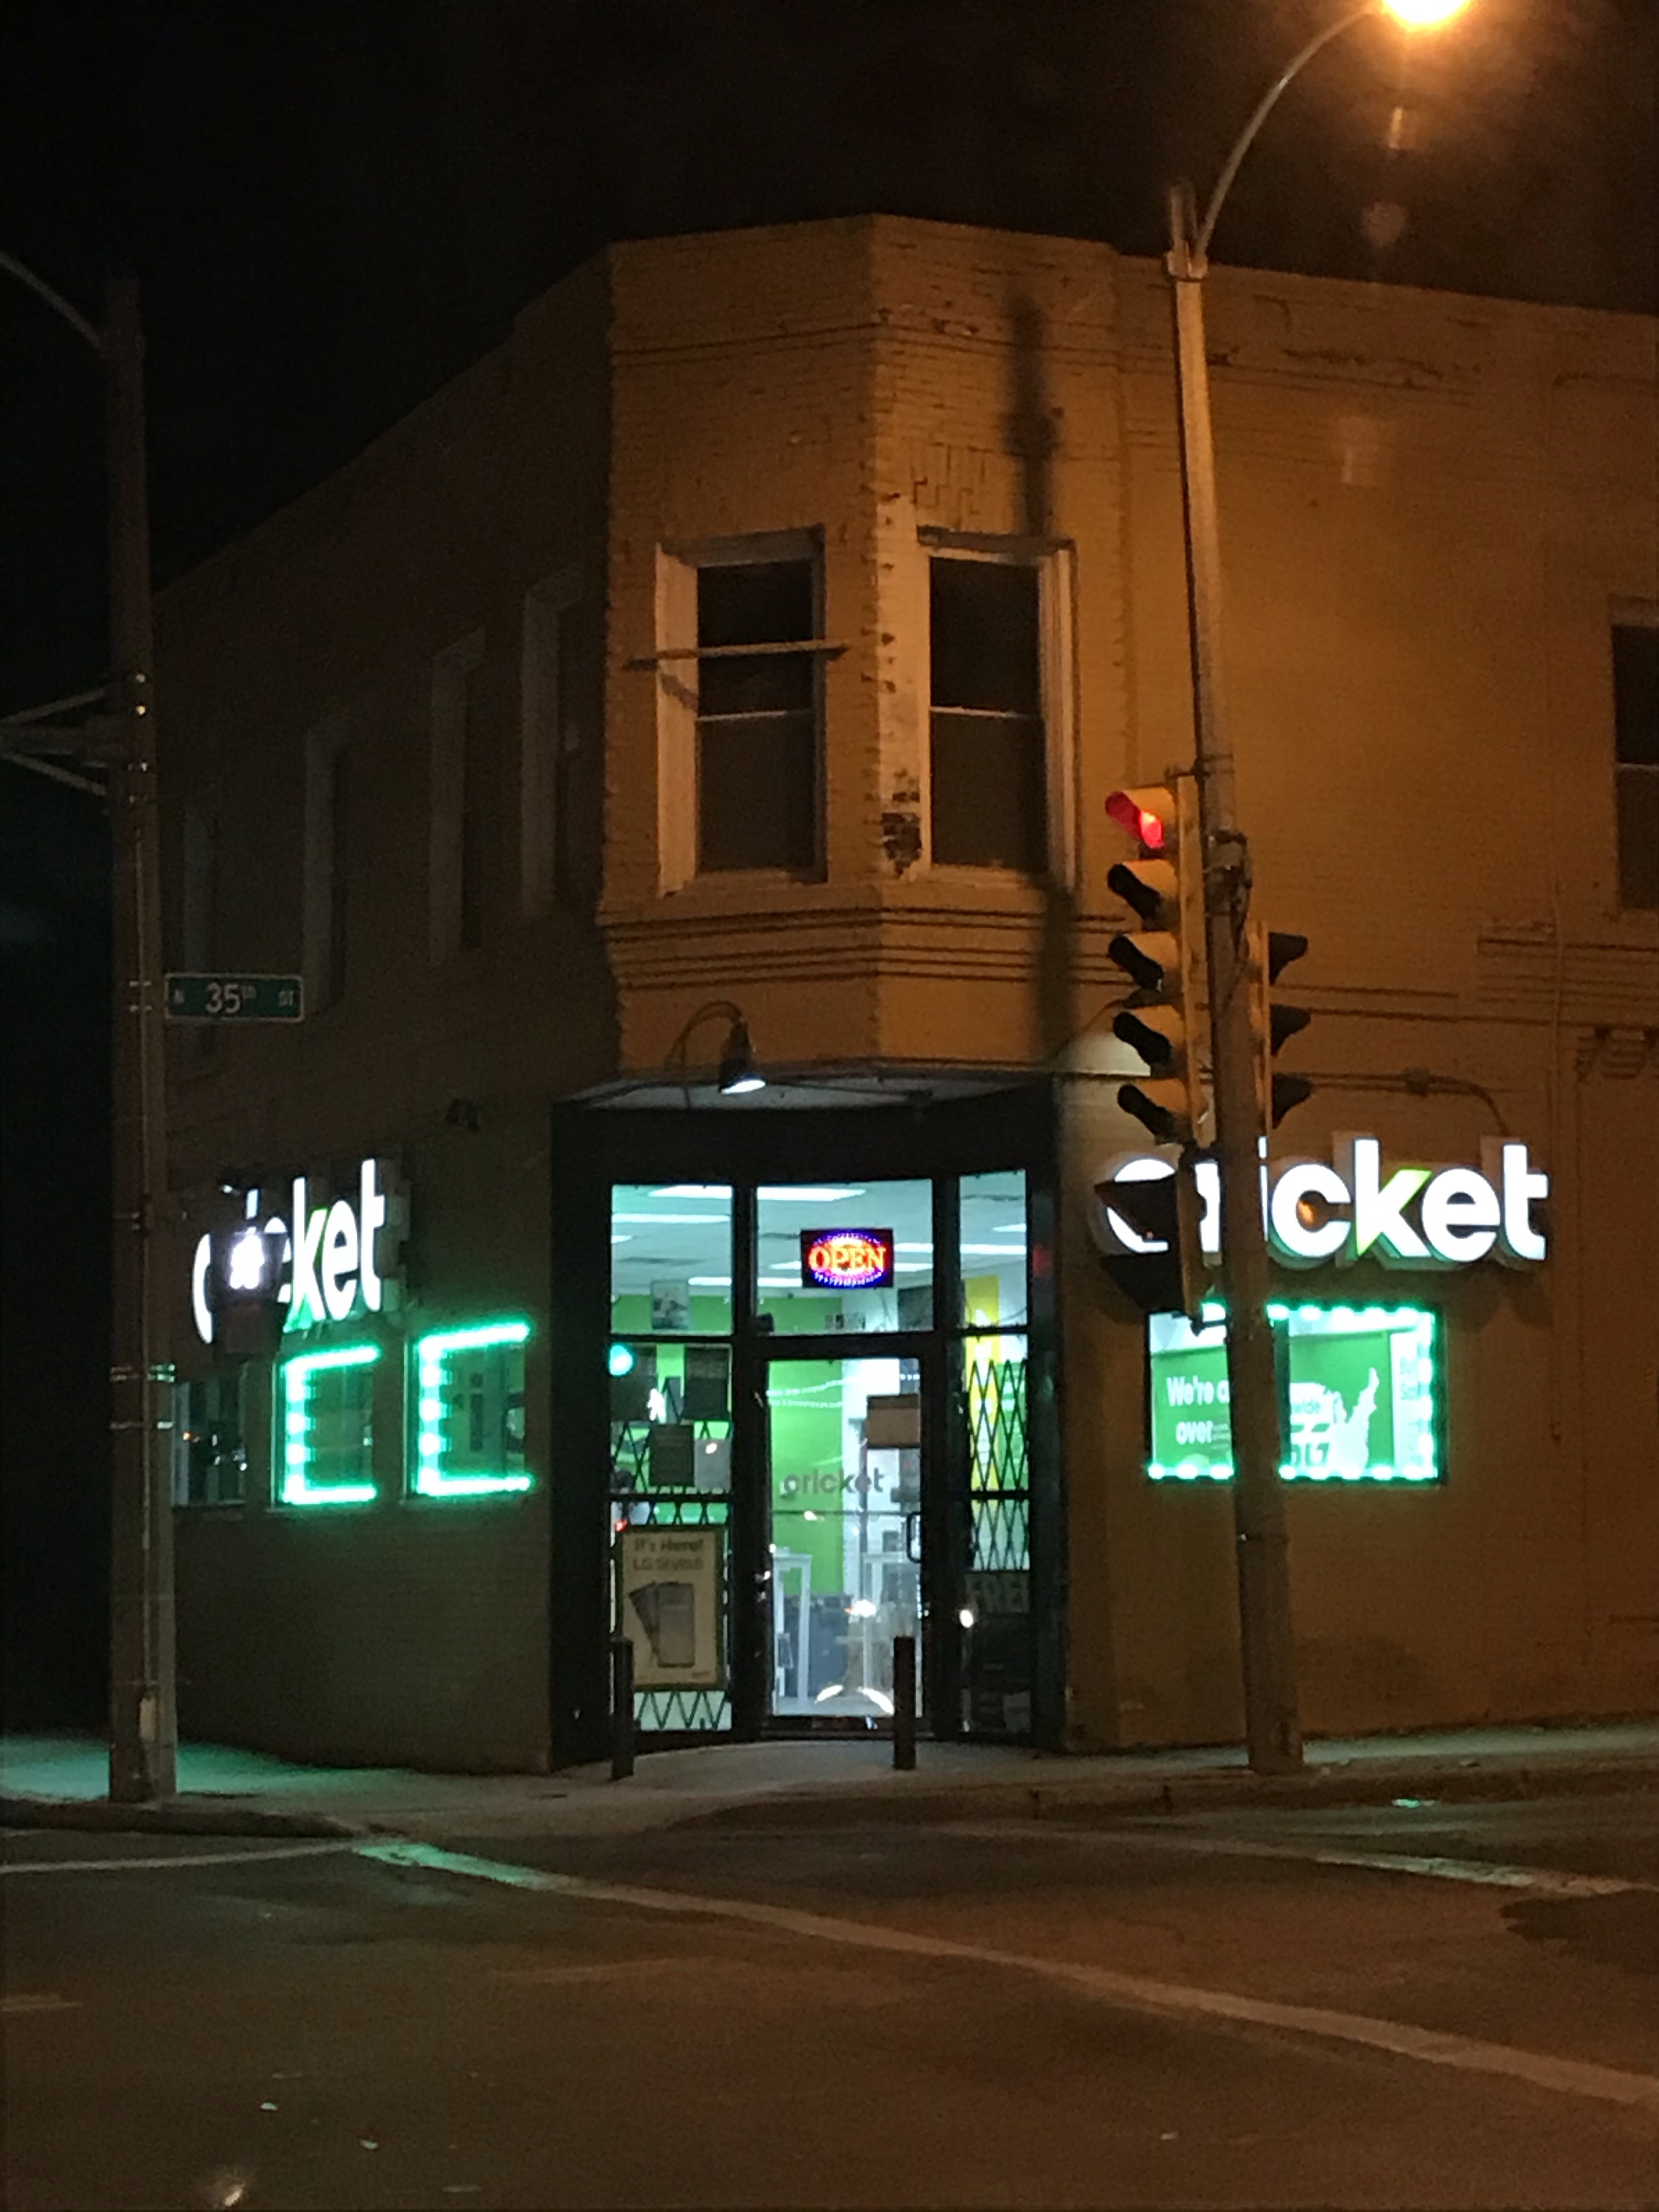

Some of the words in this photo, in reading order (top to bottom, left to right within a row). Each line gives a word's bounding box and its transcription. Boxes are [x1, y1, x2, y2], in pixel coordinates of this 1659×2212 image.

[1107, 1136, 1549, 1263] crcket
[192, 1158, 385, 1344] cket
[809, 1245, 887, 1273] OPEN
[1166, 1375, 1215, 1407] We're
[1176, 1420, 1214, 1445] over
